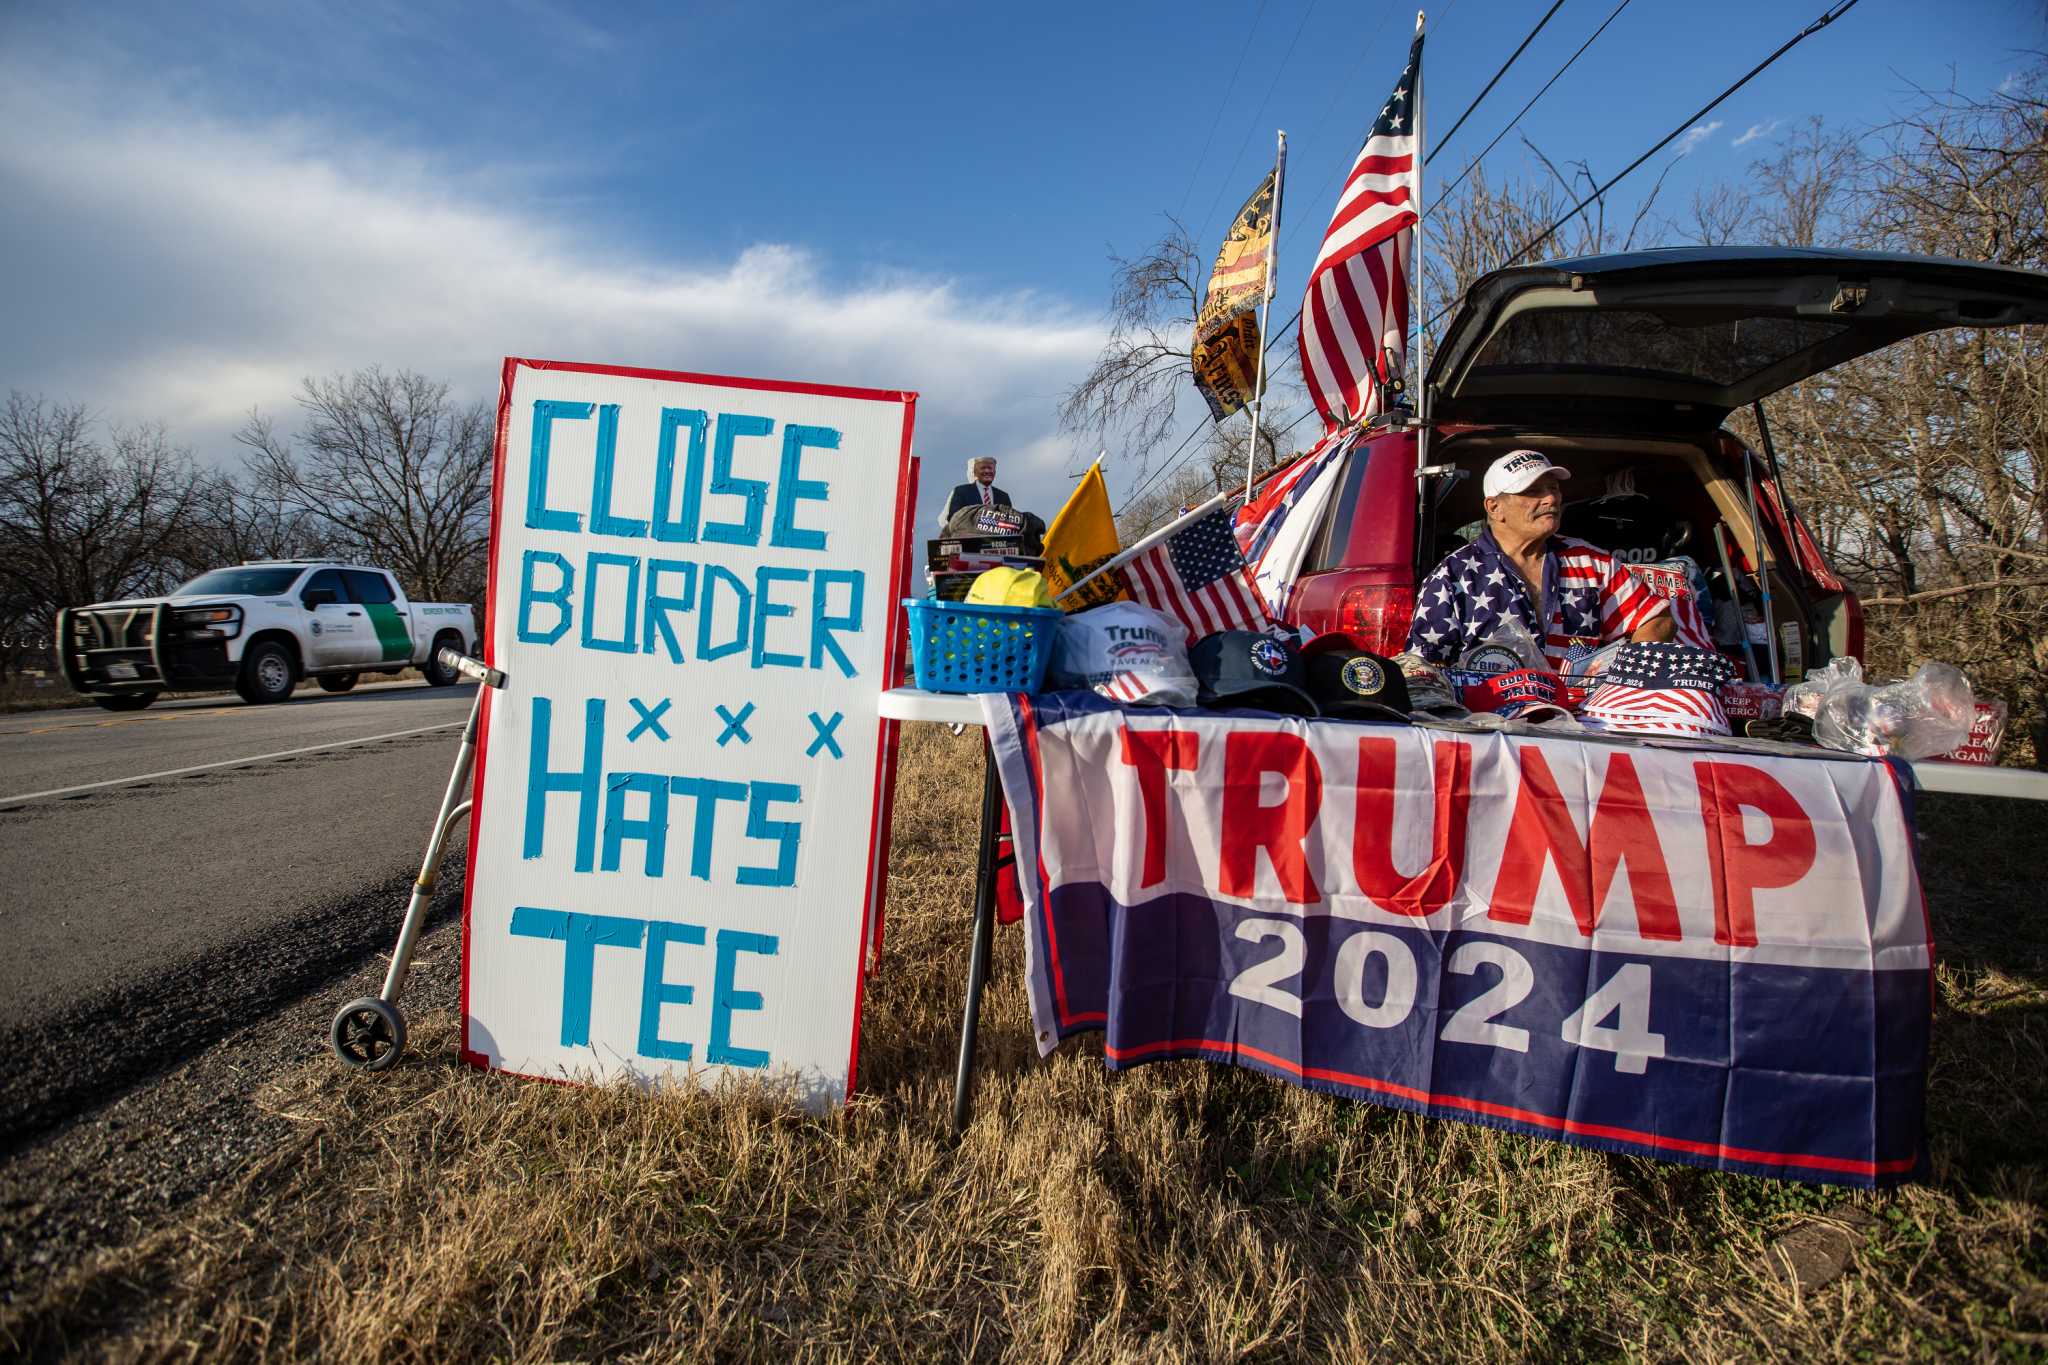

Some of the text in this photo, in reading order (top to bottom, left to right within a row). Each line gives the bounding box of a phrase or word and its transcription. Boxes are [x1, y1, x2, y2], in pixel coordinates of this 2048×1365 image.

[525, 399, 843, 551] CLOSE
[518, 549, 866, 679] BORDER
[1672, 678, 1714, 690] TRUMP
[523, 696, 803, 888] HATS
[1120, 723, 1818, 948] TRUMP
[510, 906, 779, 1069] TEE
[1228, 915, 1667, 1075] 2024
